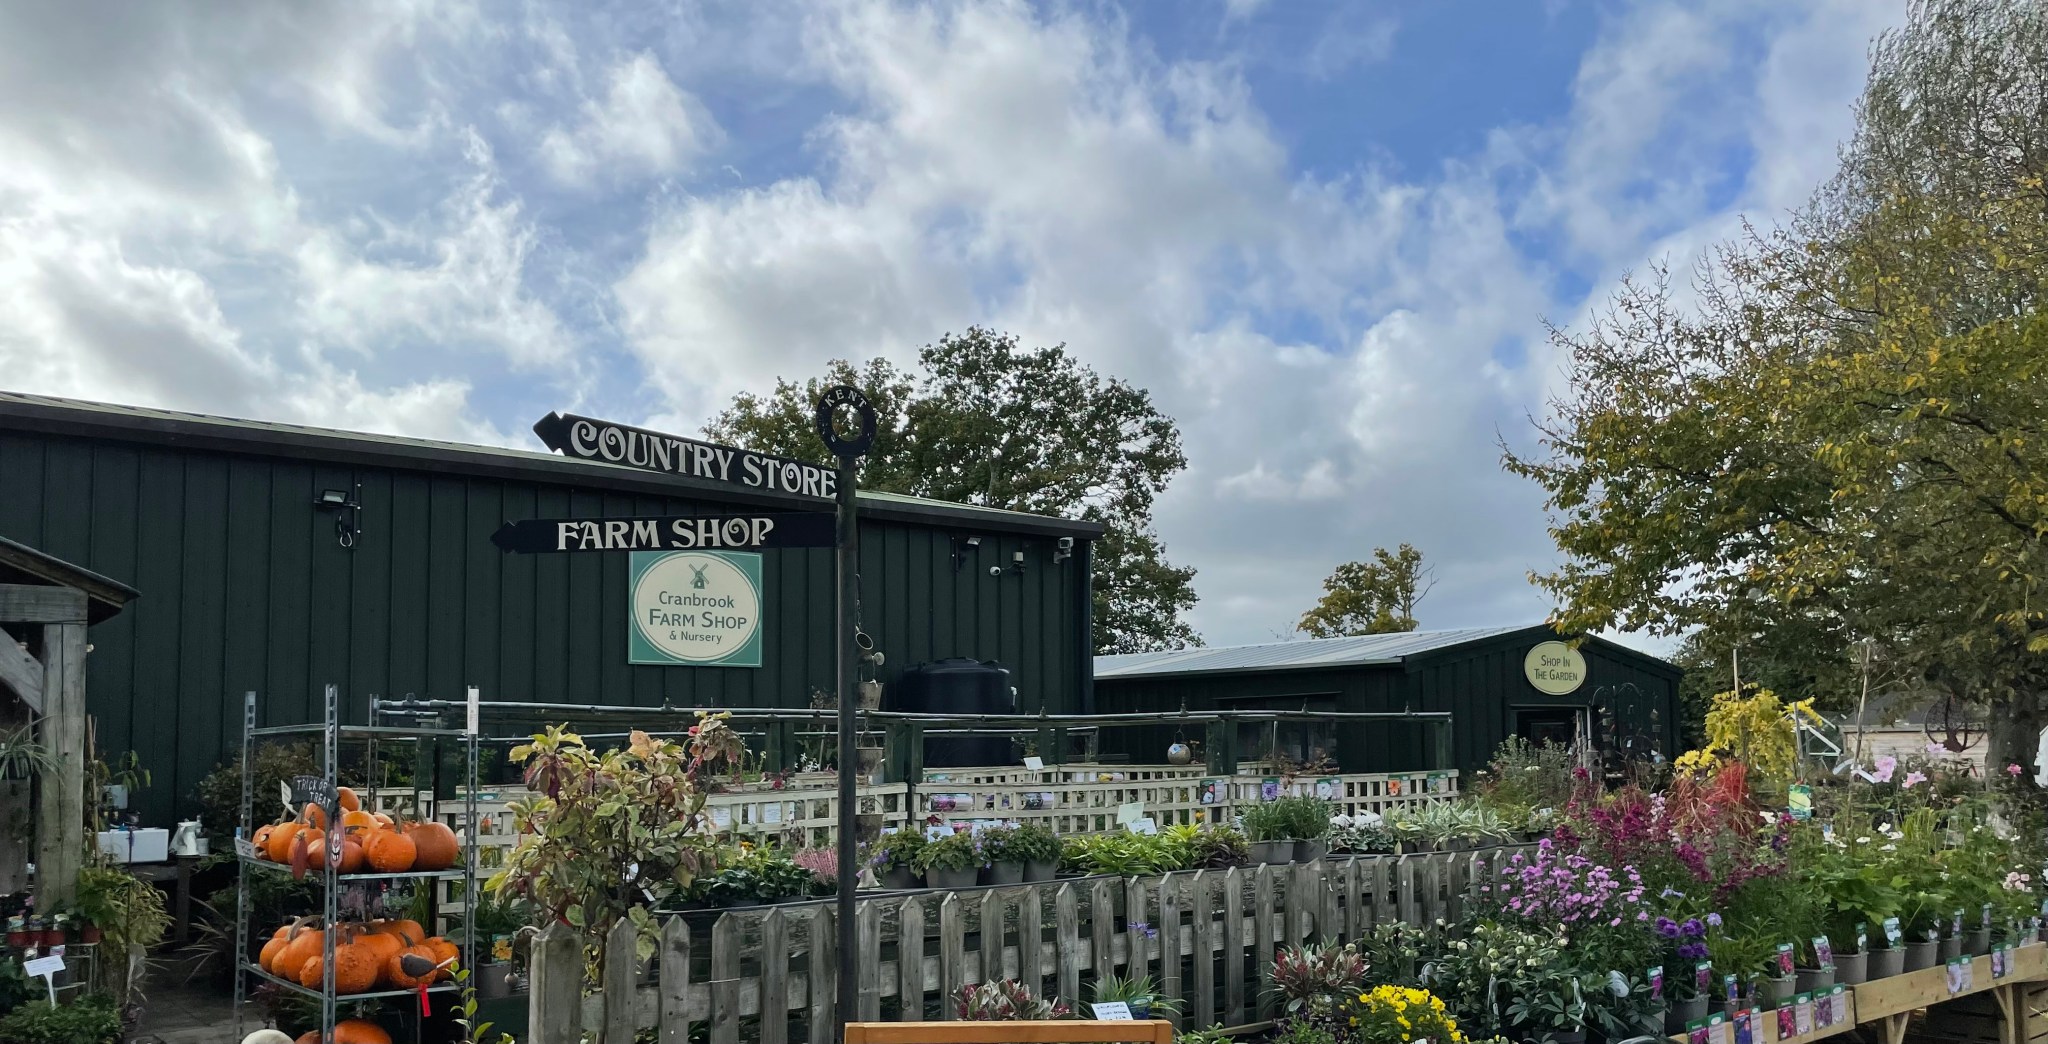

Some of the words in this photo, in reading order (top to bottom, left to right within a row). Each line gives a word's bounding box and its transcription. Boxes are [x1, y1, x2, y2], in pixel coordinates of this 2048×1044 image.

[825, 389, 867, 408] KENT
[570, 420, 735, 481] COUNTRY
[742, 453, 838, 499] STORE
[557, 520, 661, 550] FARM
[671, 517, 775, 548] SHOP
[658, 590, 735, 609] Cranbrook
[649, 609, 695, 627] FARM
[701, 611, 747, 629] SHOP
[669, 630, 677, 641] &
[681, 631, 723, 644] Nursery
[297, 779, 317, 790] TRICK
[318, 781, 328, 792] OR
[310, 792, 331, 808] TREAT
